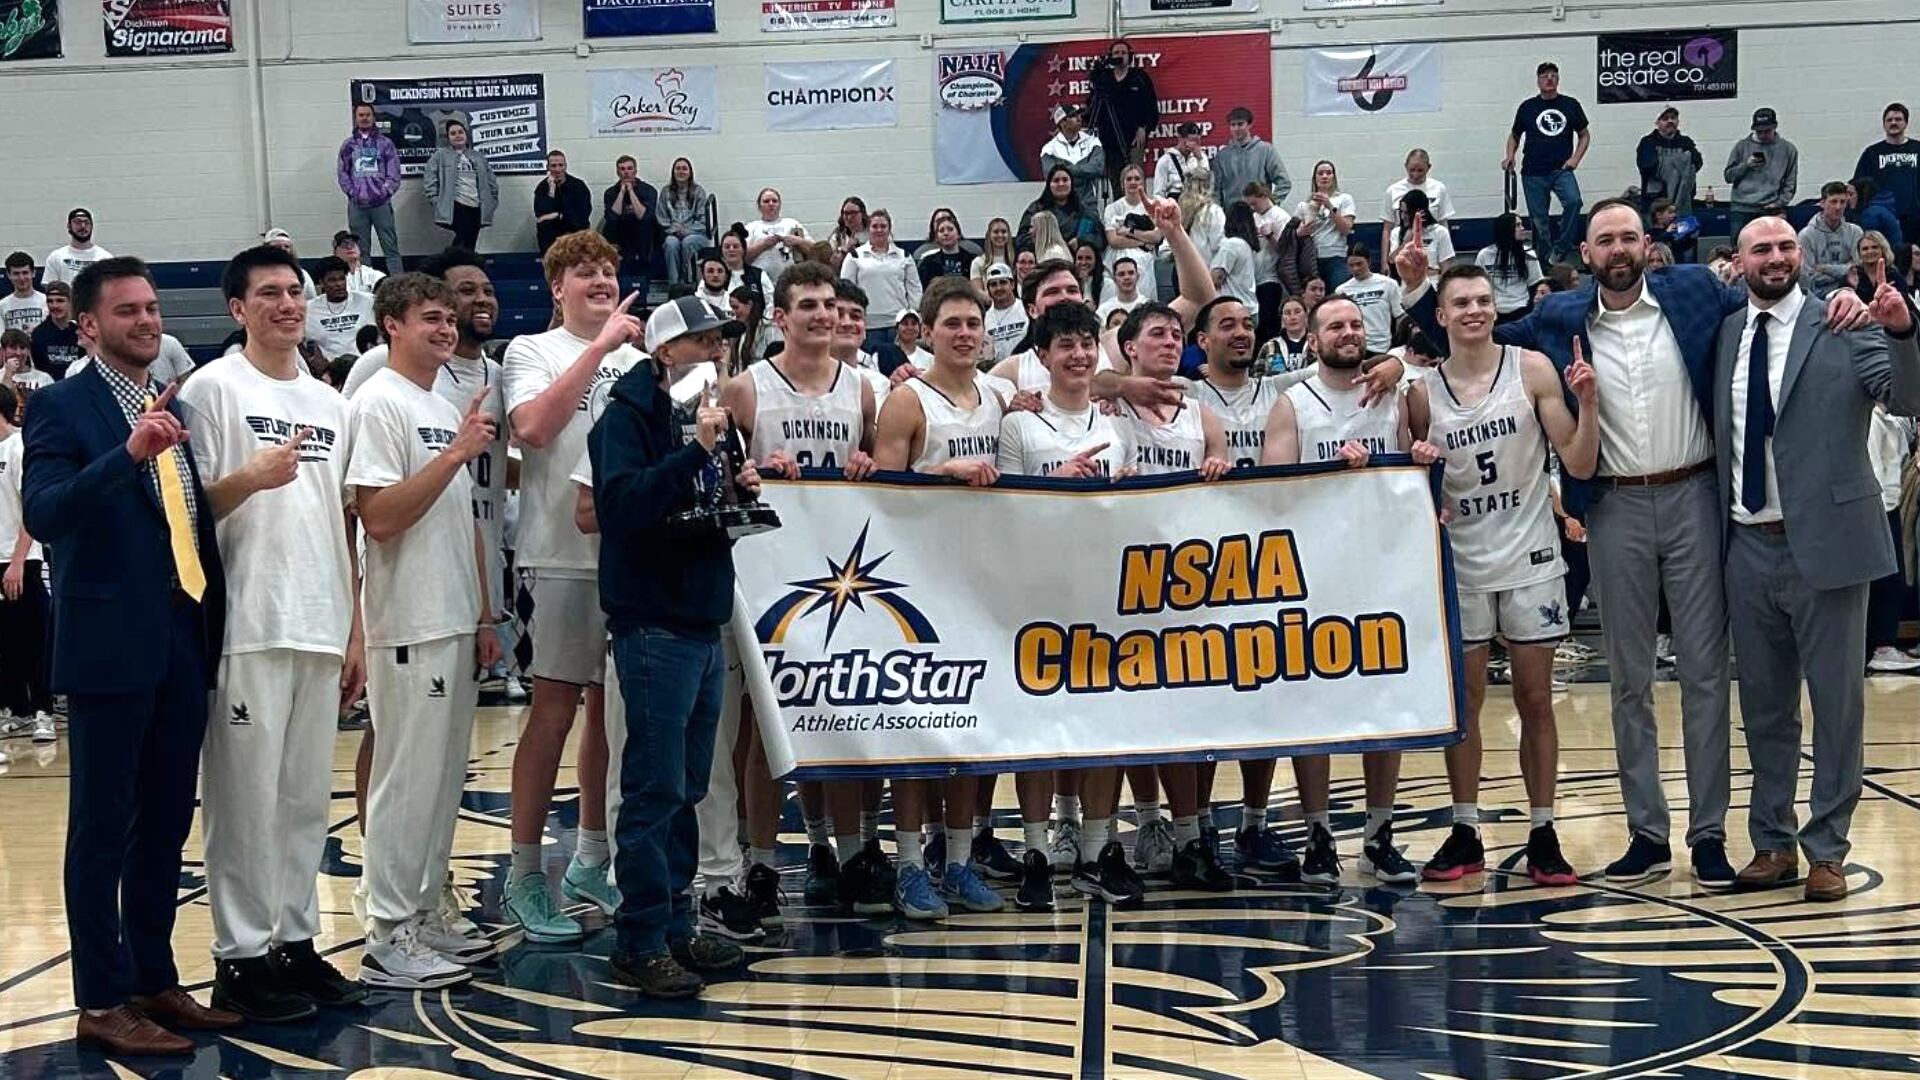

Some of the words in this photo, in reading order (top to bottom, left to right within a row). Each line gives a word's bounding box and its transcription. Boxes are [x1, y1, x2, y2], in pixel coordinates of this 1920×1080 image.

[447, 4, 501, 16] SUITES
[771, 2, 819, 13] INTERNET
[828, 2, 841, 10] TV
[124, 20, 169, 28] Dickinson
[460, 23, 501, 31] MARRIOT
[112, 28, 228, 51] Signarama
[940, 53, 1004, 80] NAIA
[1600, 48, 1635, 67] the
[1640, 45, 1681, 66] real
[1599, 67, 1669, 86] estate
[390, 87, 441, 100] DICKINSON
[443, 86, 474, 98] STATE
[476, 85, 499, 97] BLUE
[501, 83, 538, 96] HAWKS
[479, 106, 531, 121] CUSTOMIZE
[609, 94, 661, 118] Baker
[665, 92, 698, 125] Boy
[479, 126, 503, 139] YOUR
[504, 123, 529, 135] GEAR
[512, 142, 534, 153] NOW
[577, 366, 624, 411] DICKINSO
[782, 419, 849, 442] DICKINSON
[1446, 415, 1517, 451] DICKINSON
[1475, 450, 1498, 486] 5
[1459, 489, 1521, 517] STATE
[1118, 529, 1308, 615] NSAA
[1014, 607, 1409, 696] Champion
[792, 713, 870, 732] Athletic
[872, 711, 978, 731] Association
